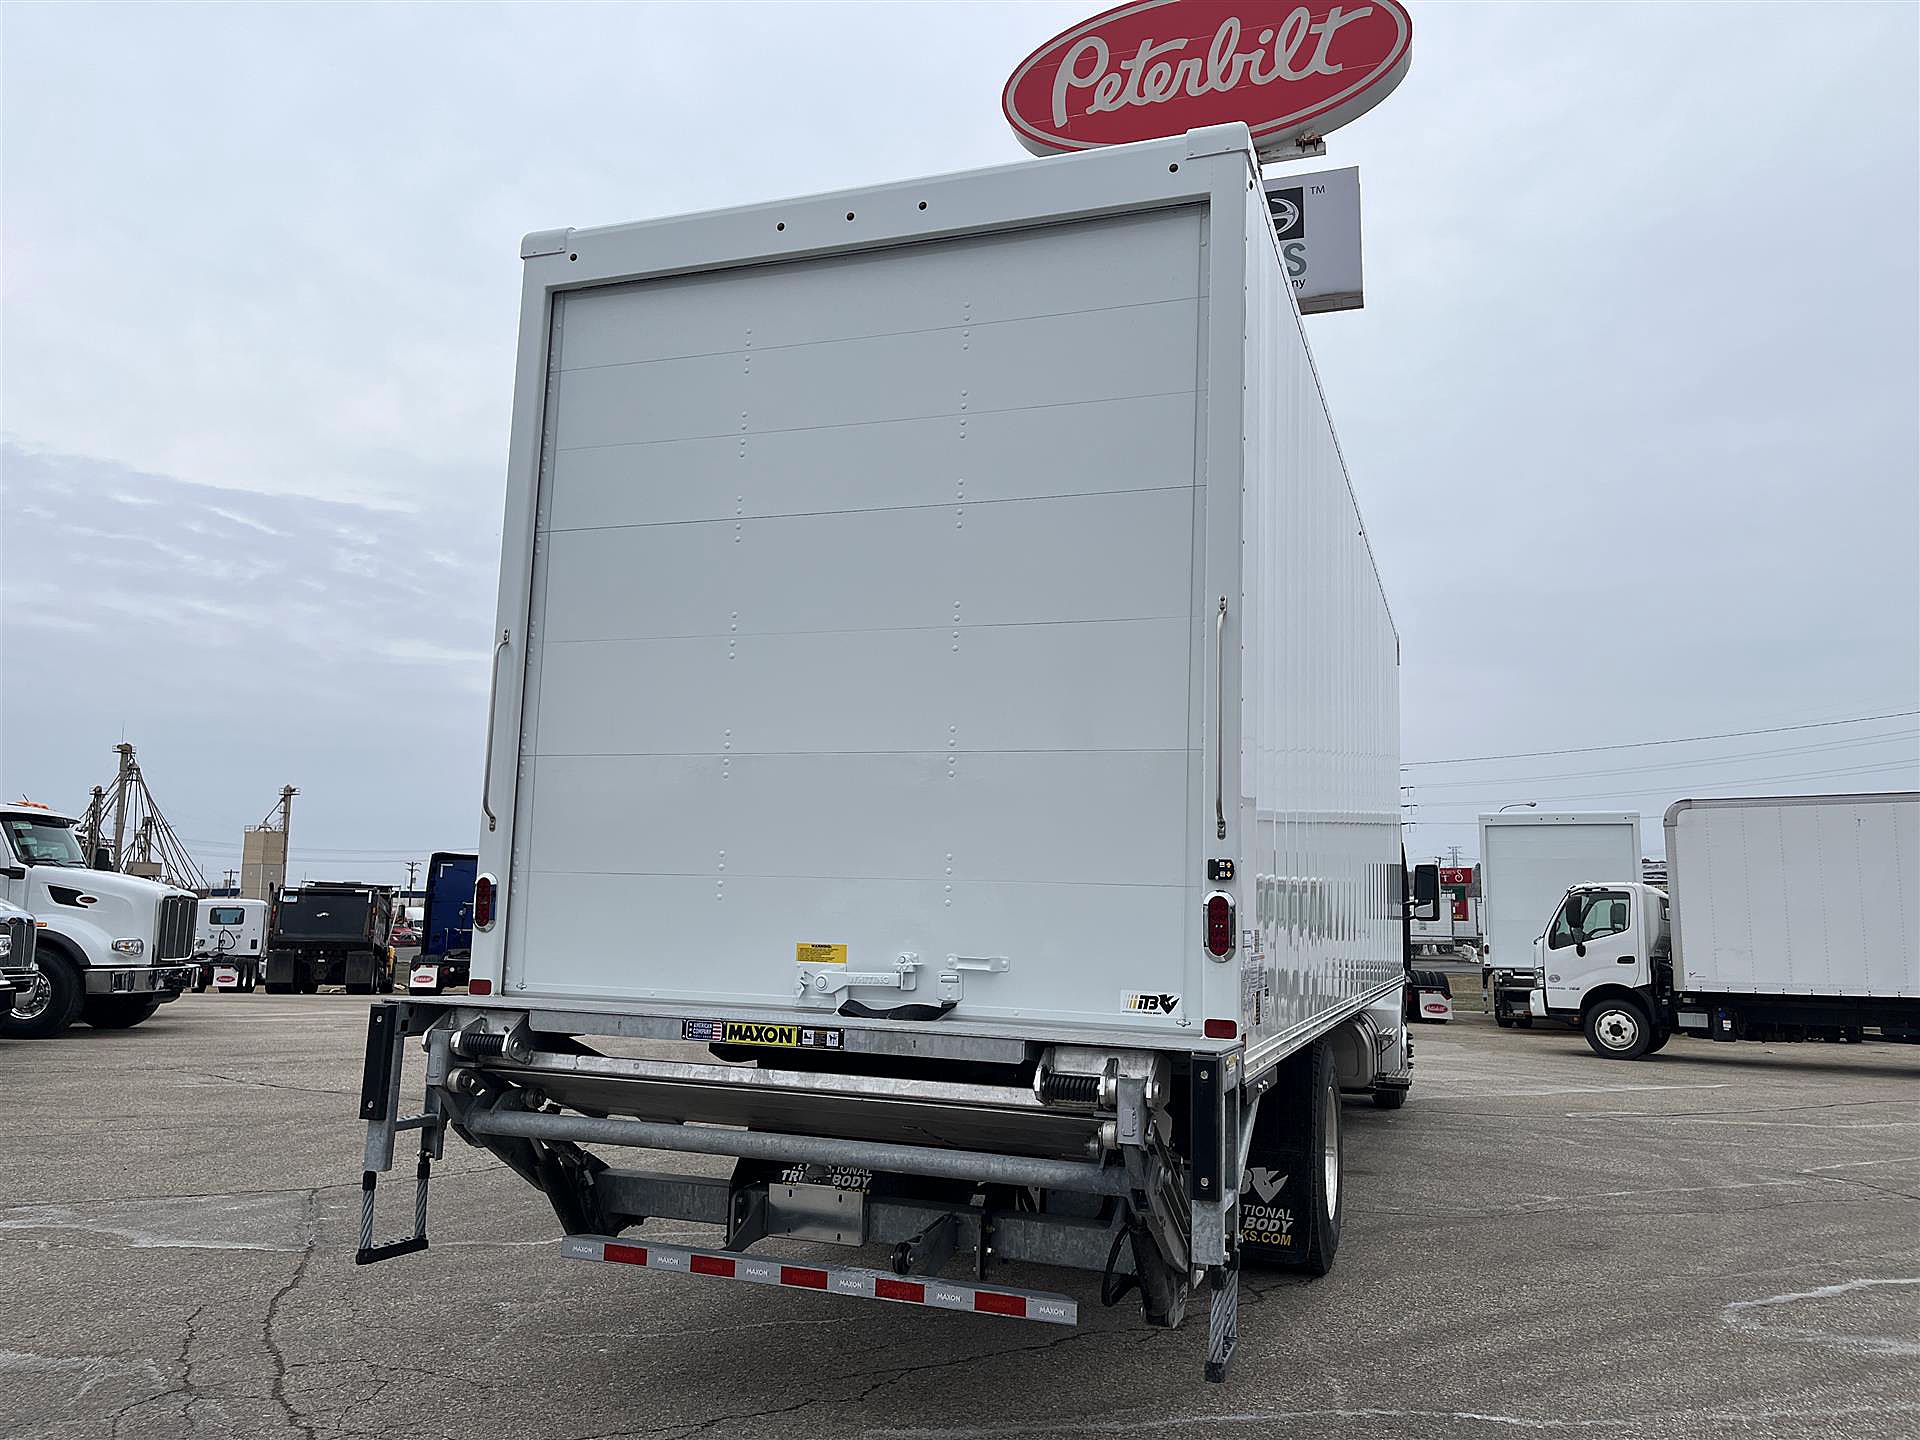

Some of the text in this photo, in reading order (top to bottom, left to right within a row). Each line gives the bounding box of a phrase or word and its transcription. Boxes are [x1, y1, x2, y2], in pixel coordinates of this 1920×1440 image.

[1051, 6, 1373, 128] Peterbilt
[1310, 185, 1326, 195] TM
[728, 1024, 793, 1043] MAXON
[832, 1174, 872, 1188] BODY
[1244, 1216, 1293, 1234] BODY
[572, 1245, 593, 1255] MAXON
[657, 1256, 680, 1266] MAXON
[745, 1266, 768, 1277] MAXON
[839, 1279, 862, 1289] MAXON
[936, 1292, 961, 1303] MAXON
[1039, 1305, 1065, 1316] MAXON
